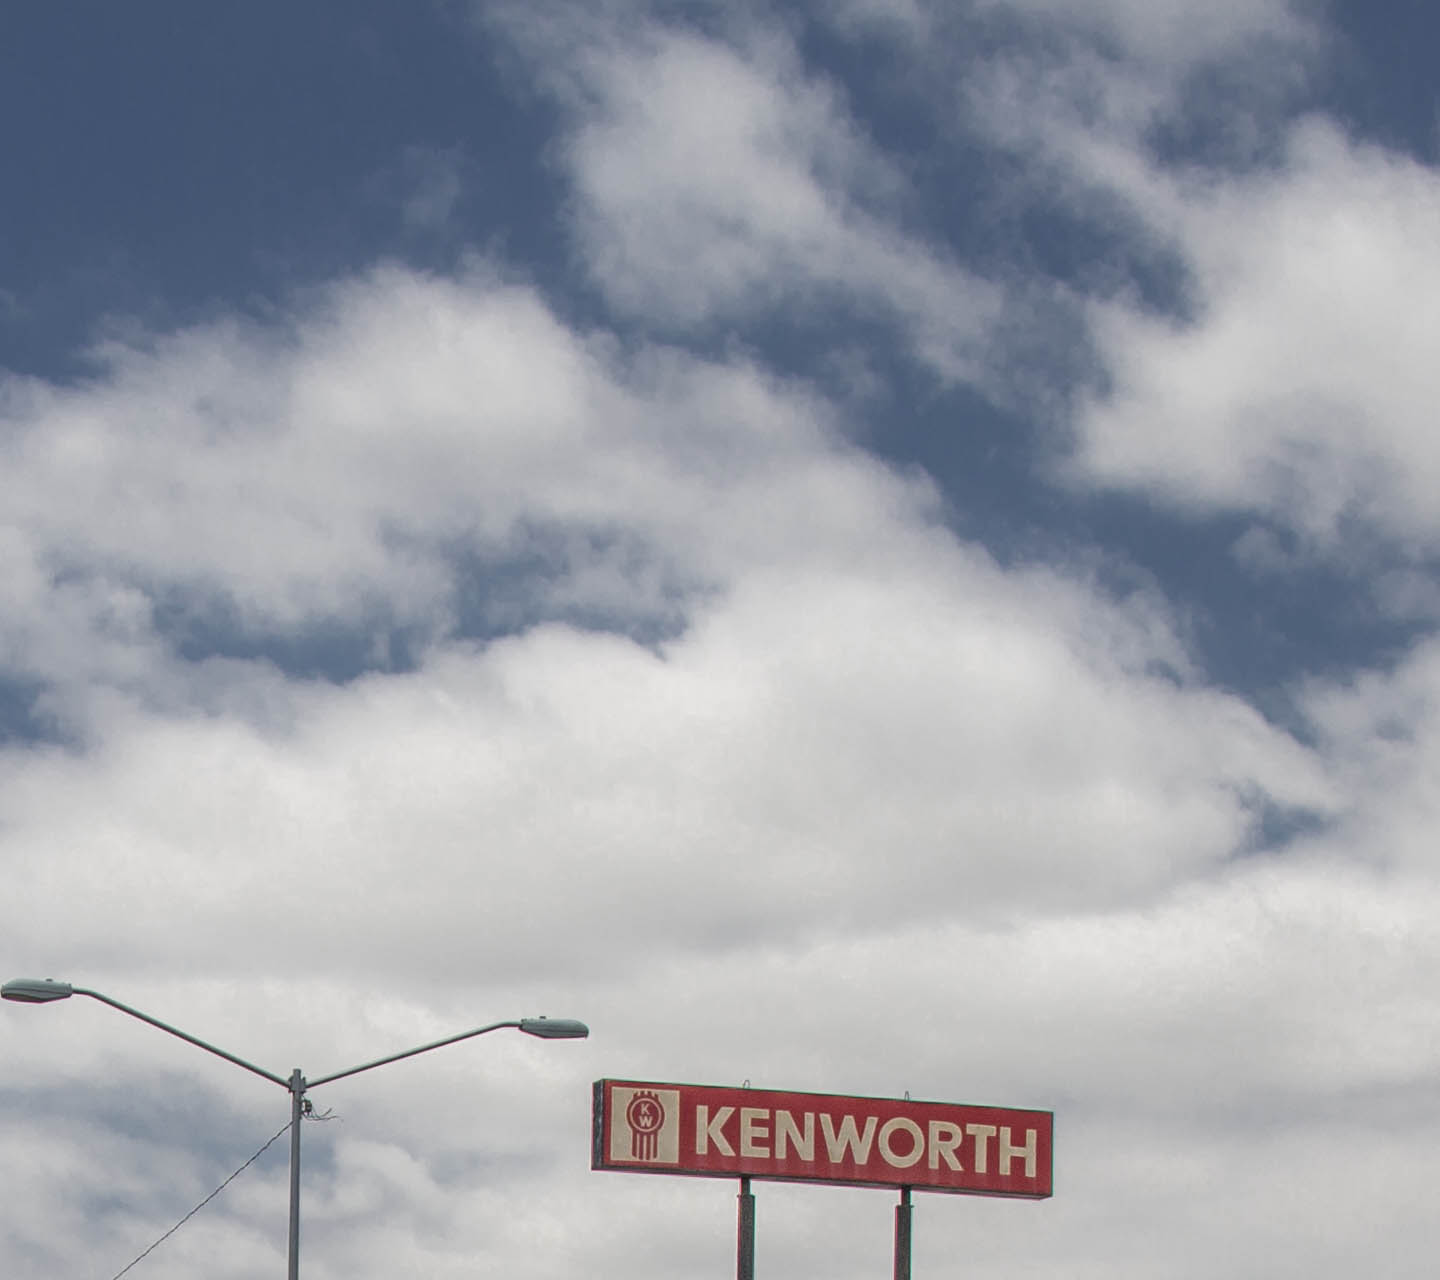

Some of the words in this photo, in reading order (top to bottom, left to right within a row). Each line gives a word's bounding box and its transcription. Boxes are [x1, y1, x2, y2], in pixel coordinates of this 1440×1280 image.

[641, 1103, 650, 1115] K
[639, 1116, 652, 1127] W
[696, 1105, 1037, 1178] KENWORTH
